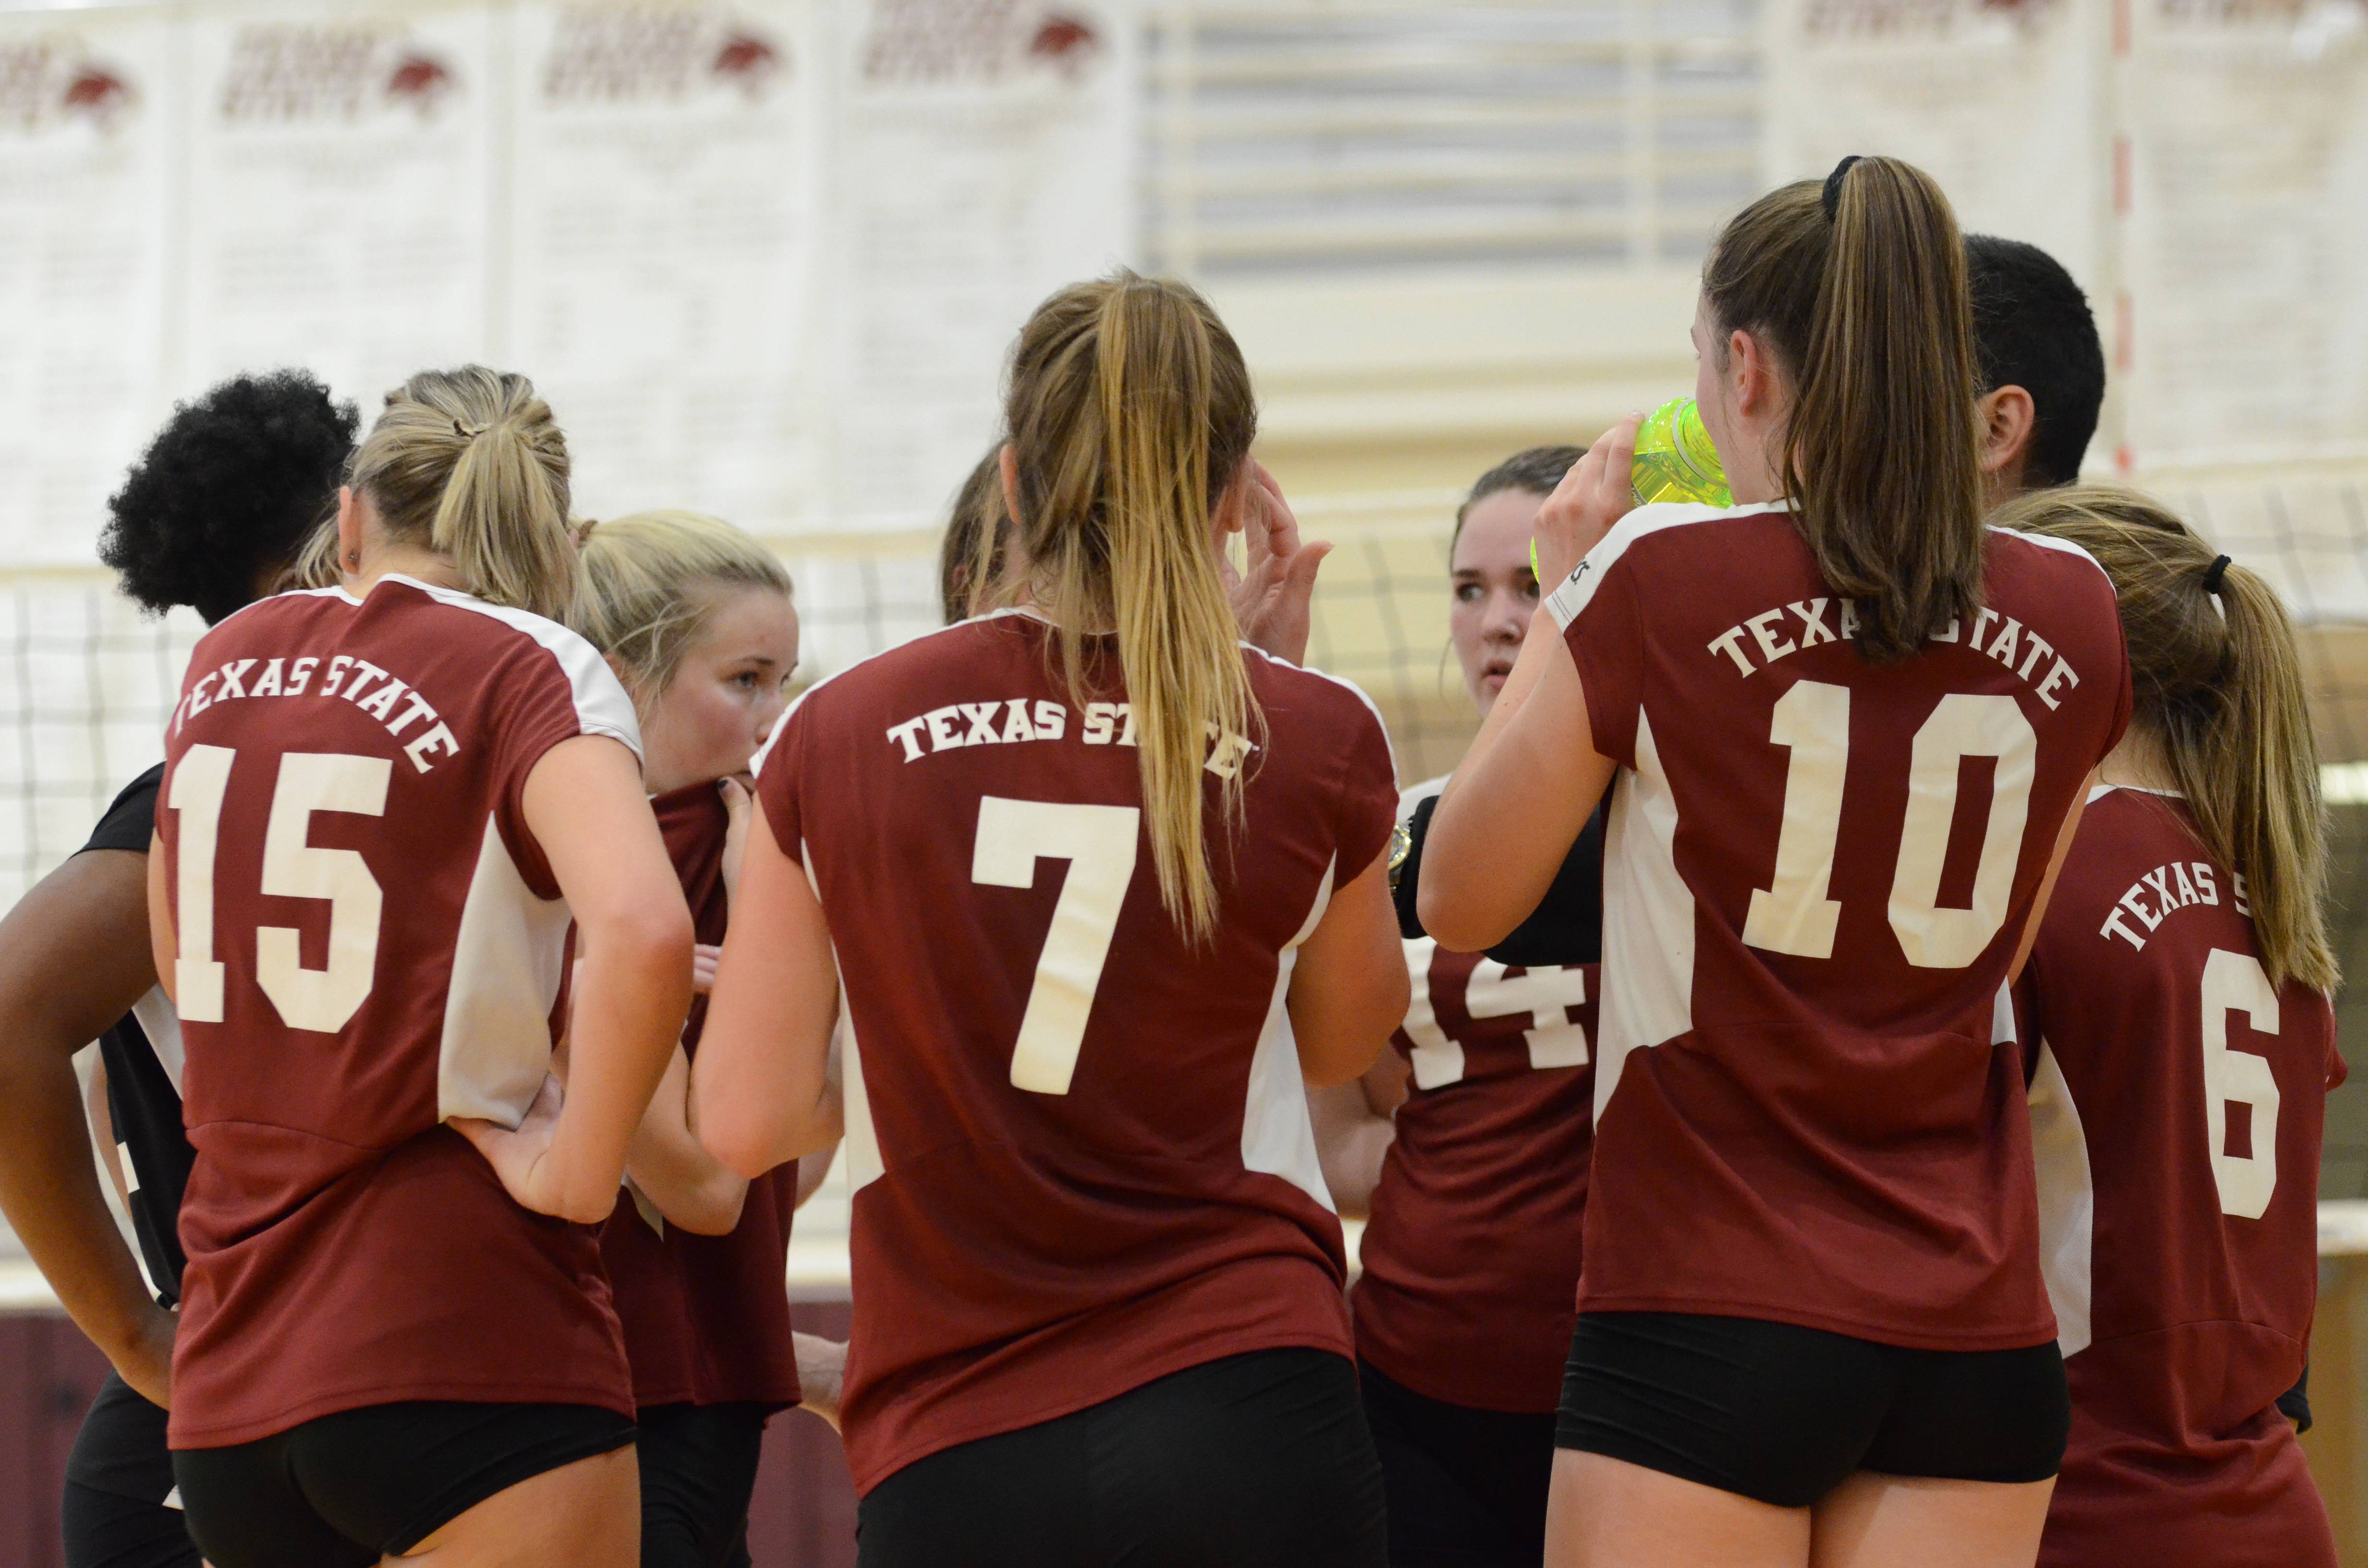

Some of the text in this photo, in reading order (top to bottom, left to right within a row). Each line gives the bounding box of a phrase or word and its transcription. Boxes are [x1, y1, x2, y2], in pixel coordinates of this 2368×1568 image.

[174, 655, 460, 774] TEXAS STATE
[886, 698, 1067, 764] TEXAS
[1708, 597, 1867, 678] TEXA
[168, 744, 393, 1034] 15
[1742, 679, 2037, 968] 10
[2099, 862, 2219, 952] TEXAS
[971, 796, 1140, 1095] 7
[2201, 948, 2280, 1220] 6
